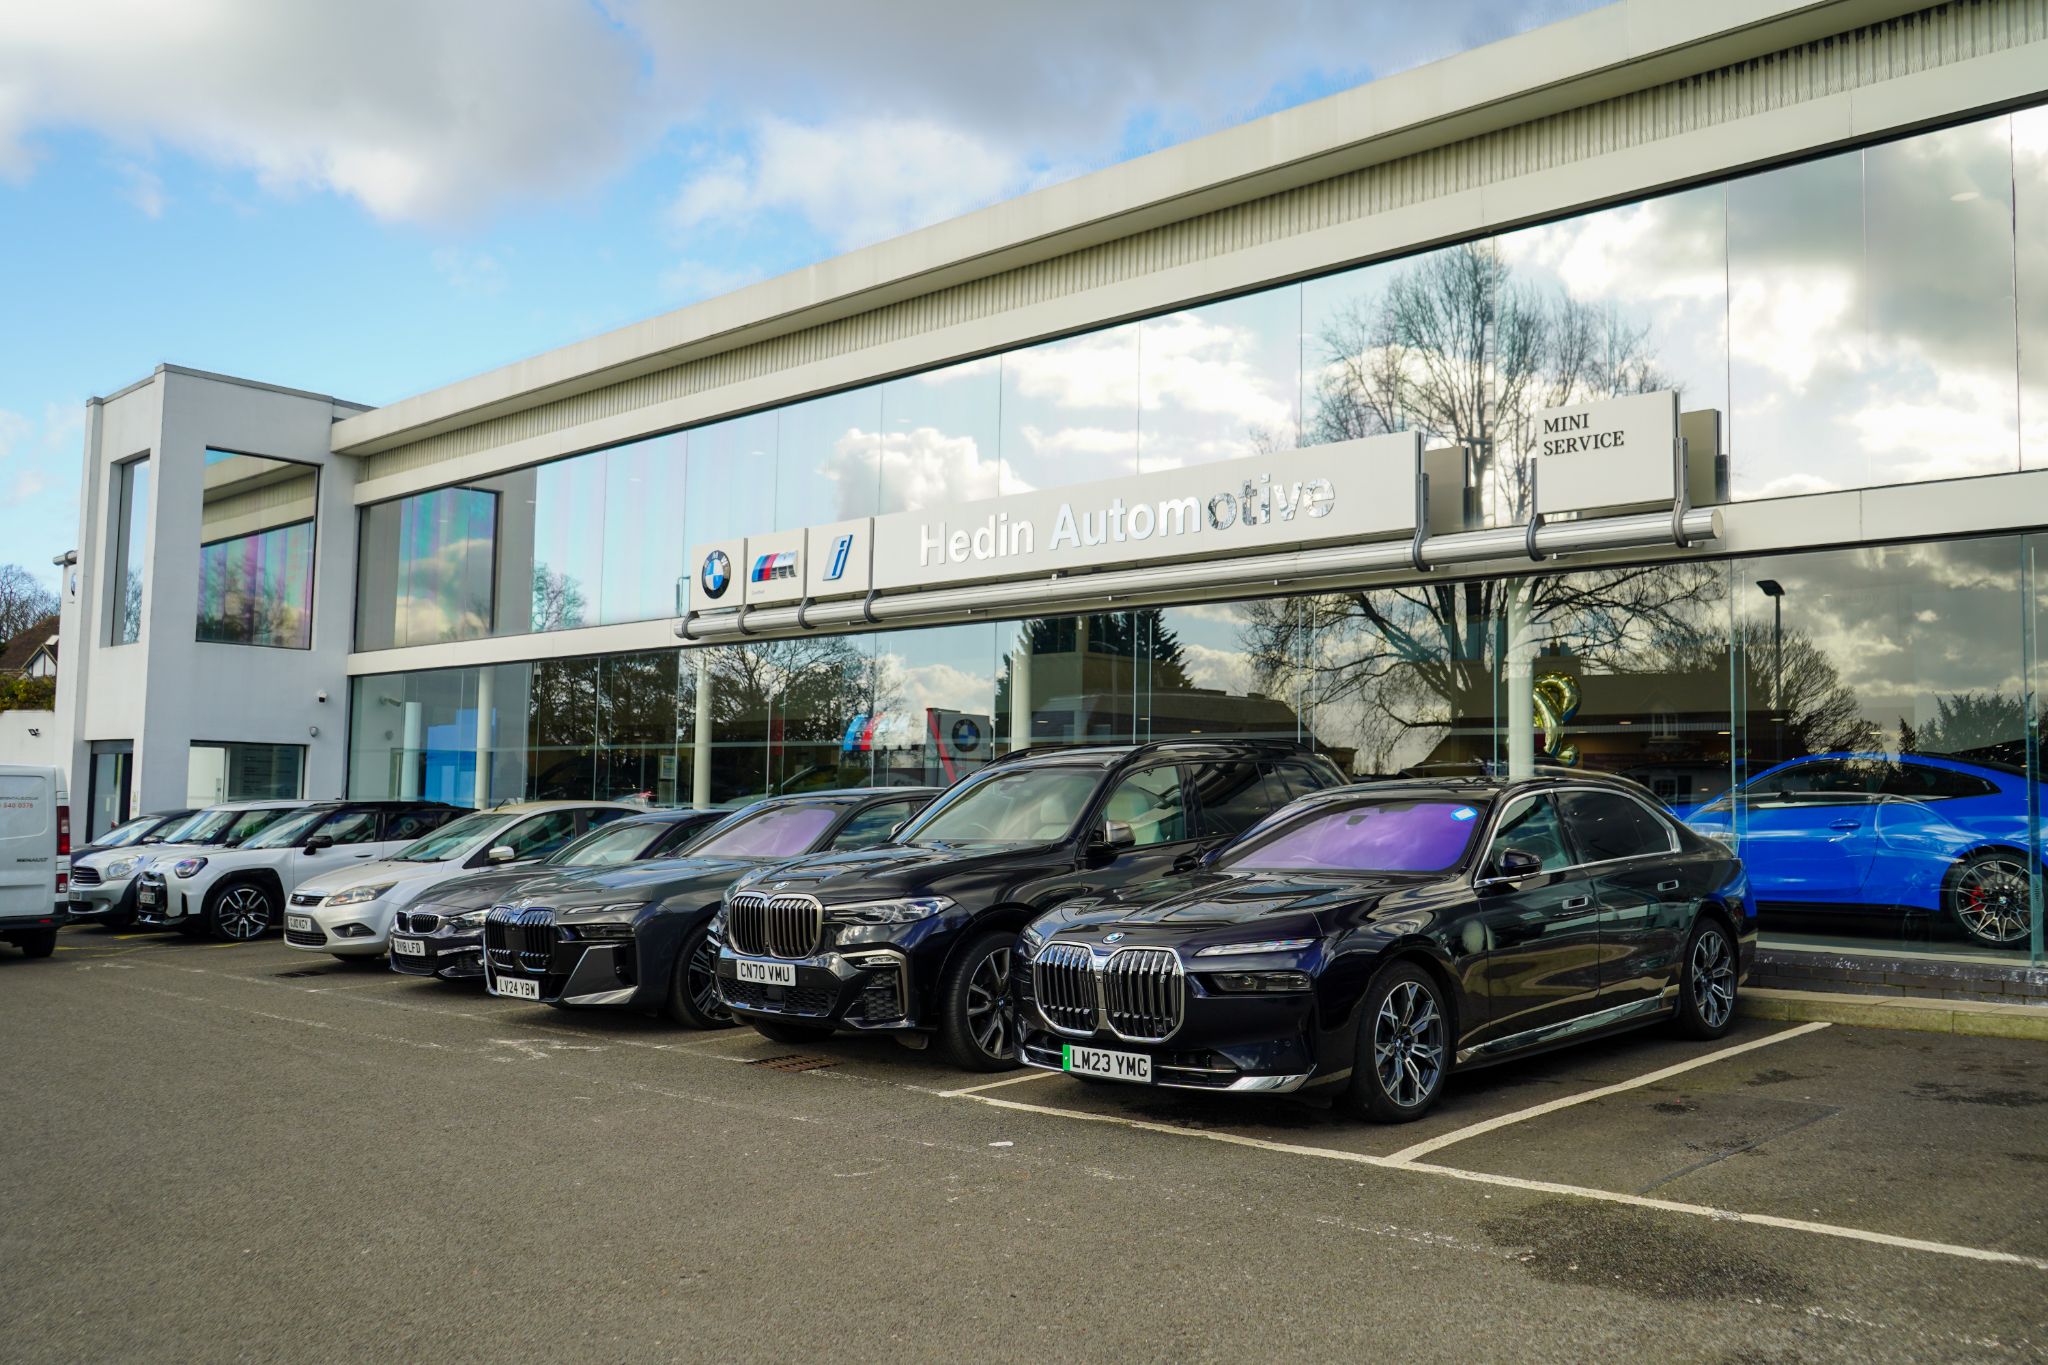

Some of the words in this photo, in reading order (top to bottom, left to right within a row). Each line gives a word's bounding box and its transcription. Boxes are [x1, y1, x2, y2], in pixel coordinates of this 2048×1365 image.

[1543, 412, 1590, 435] MINI
[1543, 430, 1625, 457] SERVICE
[919, 512, 1035, 567] Hedin
[1047, 472, 1336, 552] Automotive
[740, 962, 766, 980] CN70
[767, 965, 790, 982] VMU
[1072, 1049, 1111, 1073] LM23
[1115, 1054, 1148, 1077] YMG
